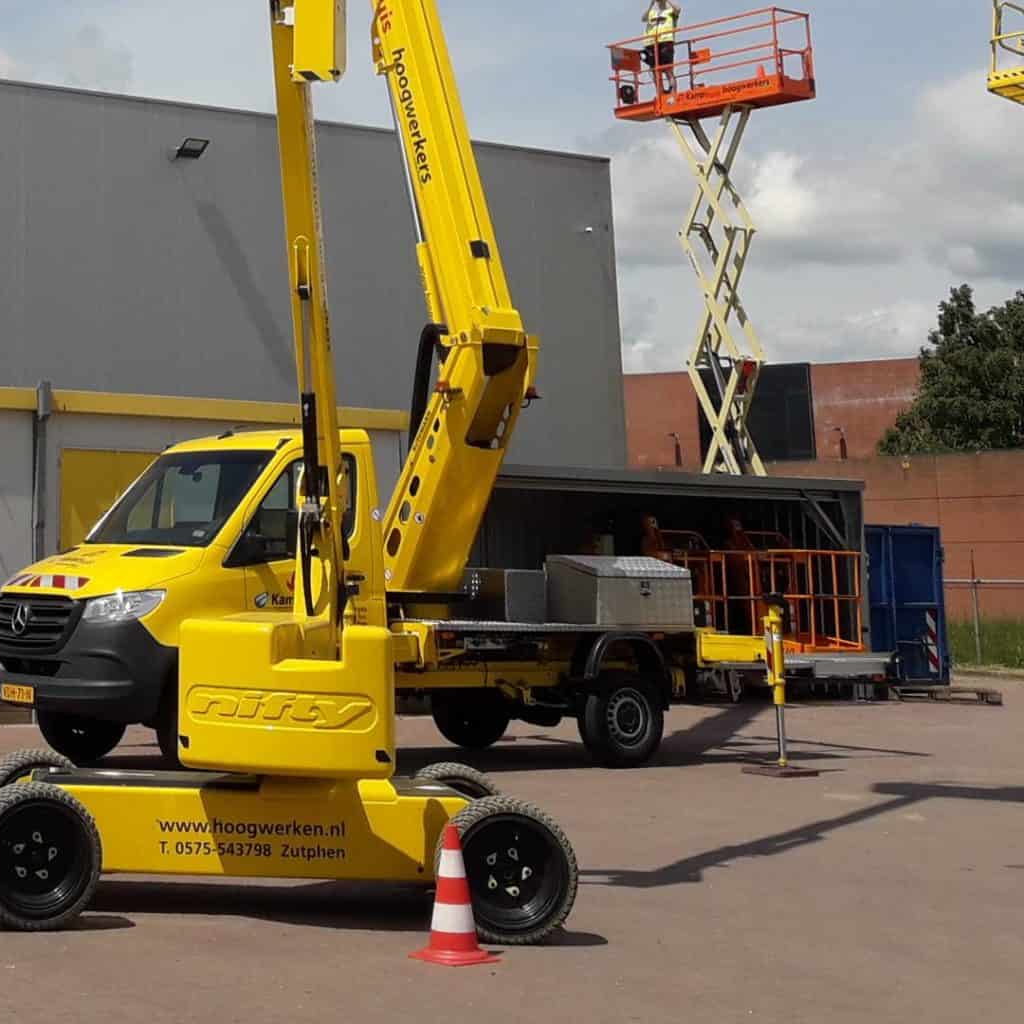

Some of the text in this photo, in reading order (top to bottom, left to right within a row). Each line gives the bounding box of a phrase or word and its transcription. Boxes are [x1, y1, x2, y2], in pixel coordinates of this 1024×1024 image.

[392, 48, 432, 184] hoogwerkers
[159, 818, 346, 838] www.hoogwerken.nl
[159, 840, 346, 860] T. 0575-543798 Zutphen
